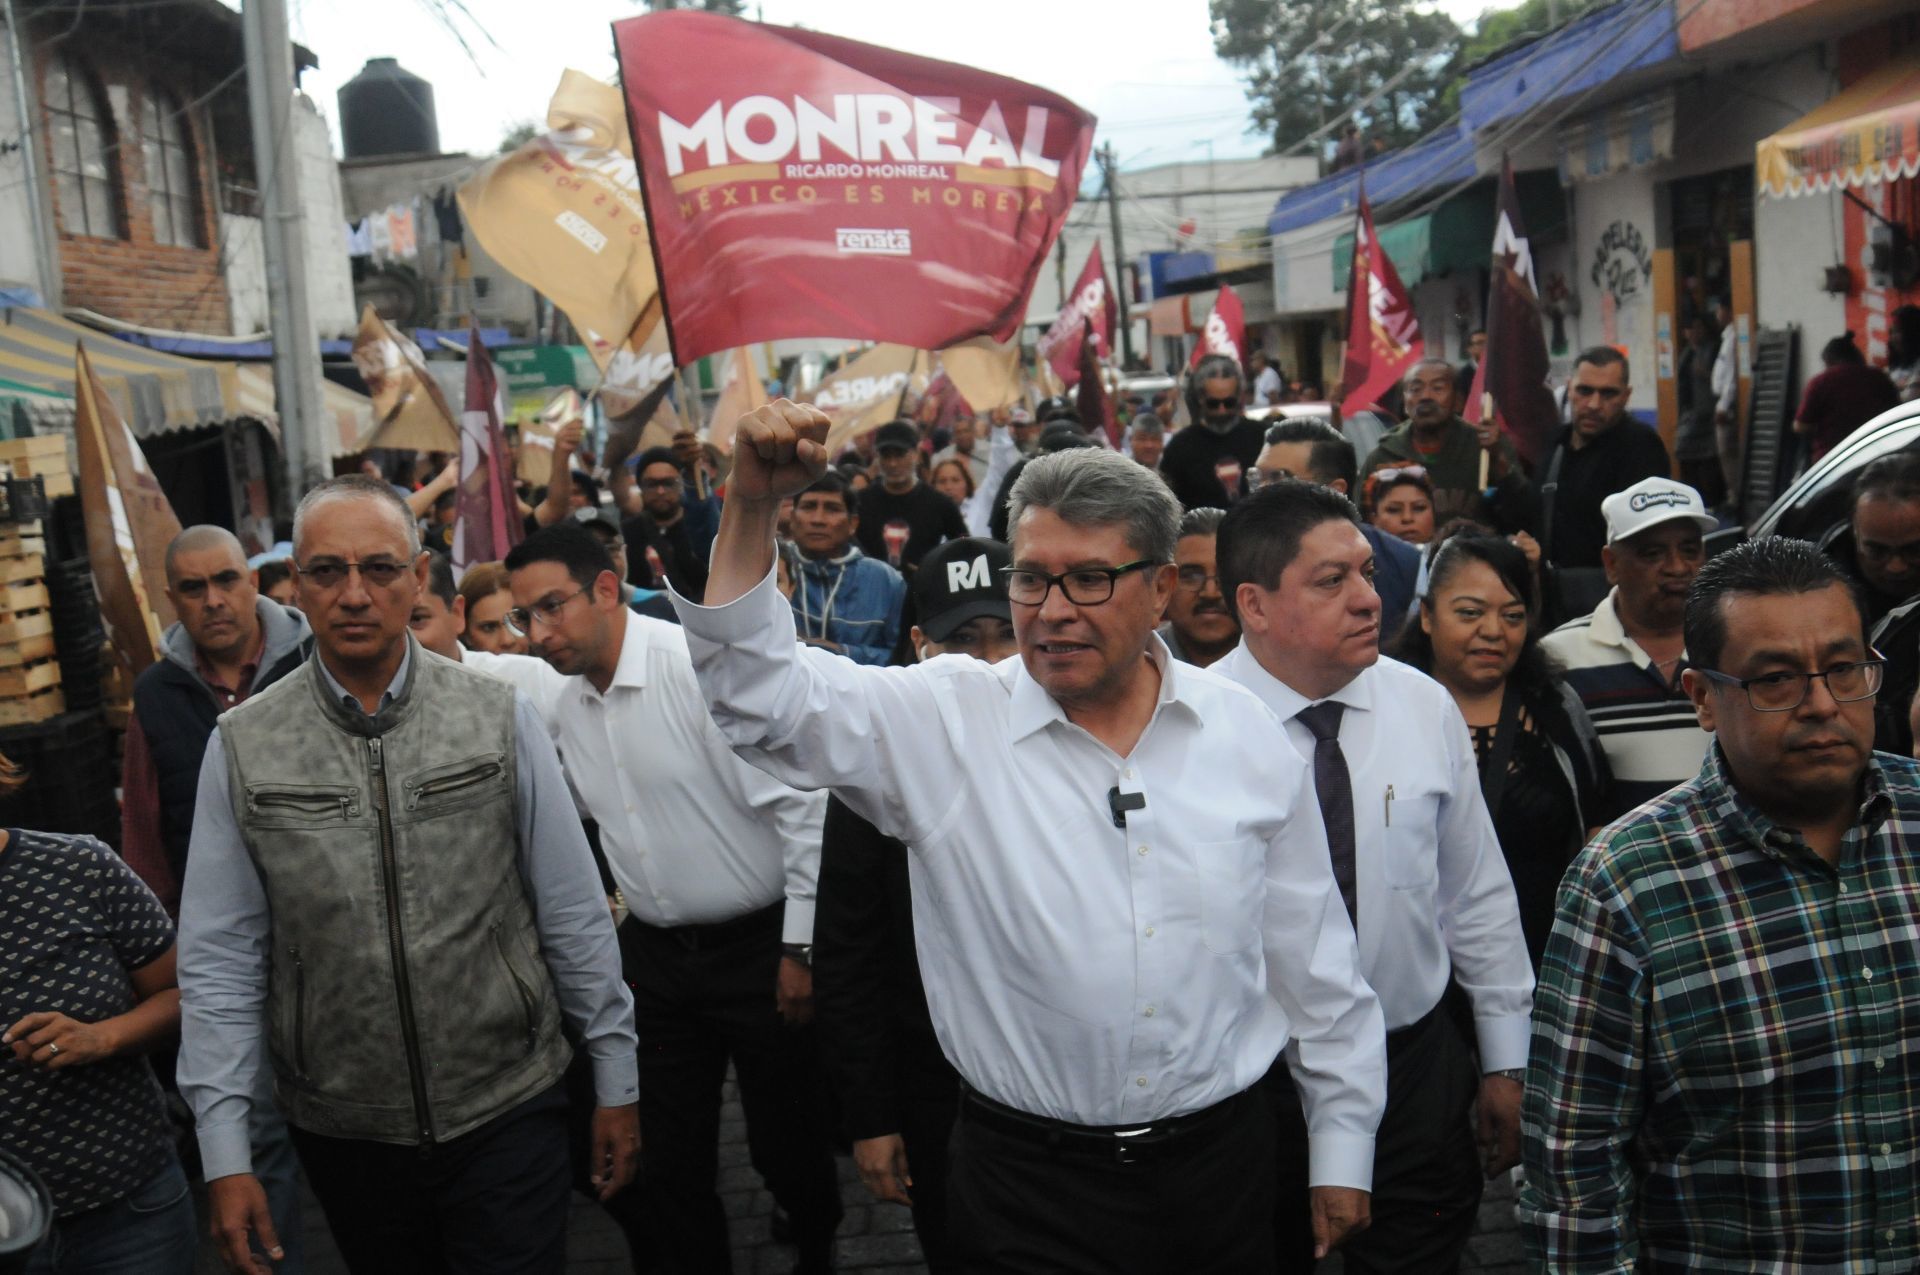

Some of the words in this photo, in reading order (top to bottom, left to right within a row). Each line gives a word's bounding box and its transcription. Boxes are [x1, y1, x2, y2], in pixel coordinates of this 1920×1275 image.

[658, 94, 1060, 177] MONREAL
[786, 164, 863, 179] RICARDO
[867, 164, 949, 180] MONREAL
[844, 184, 885, 203] ES
[836, 230, 911, 252] renata
